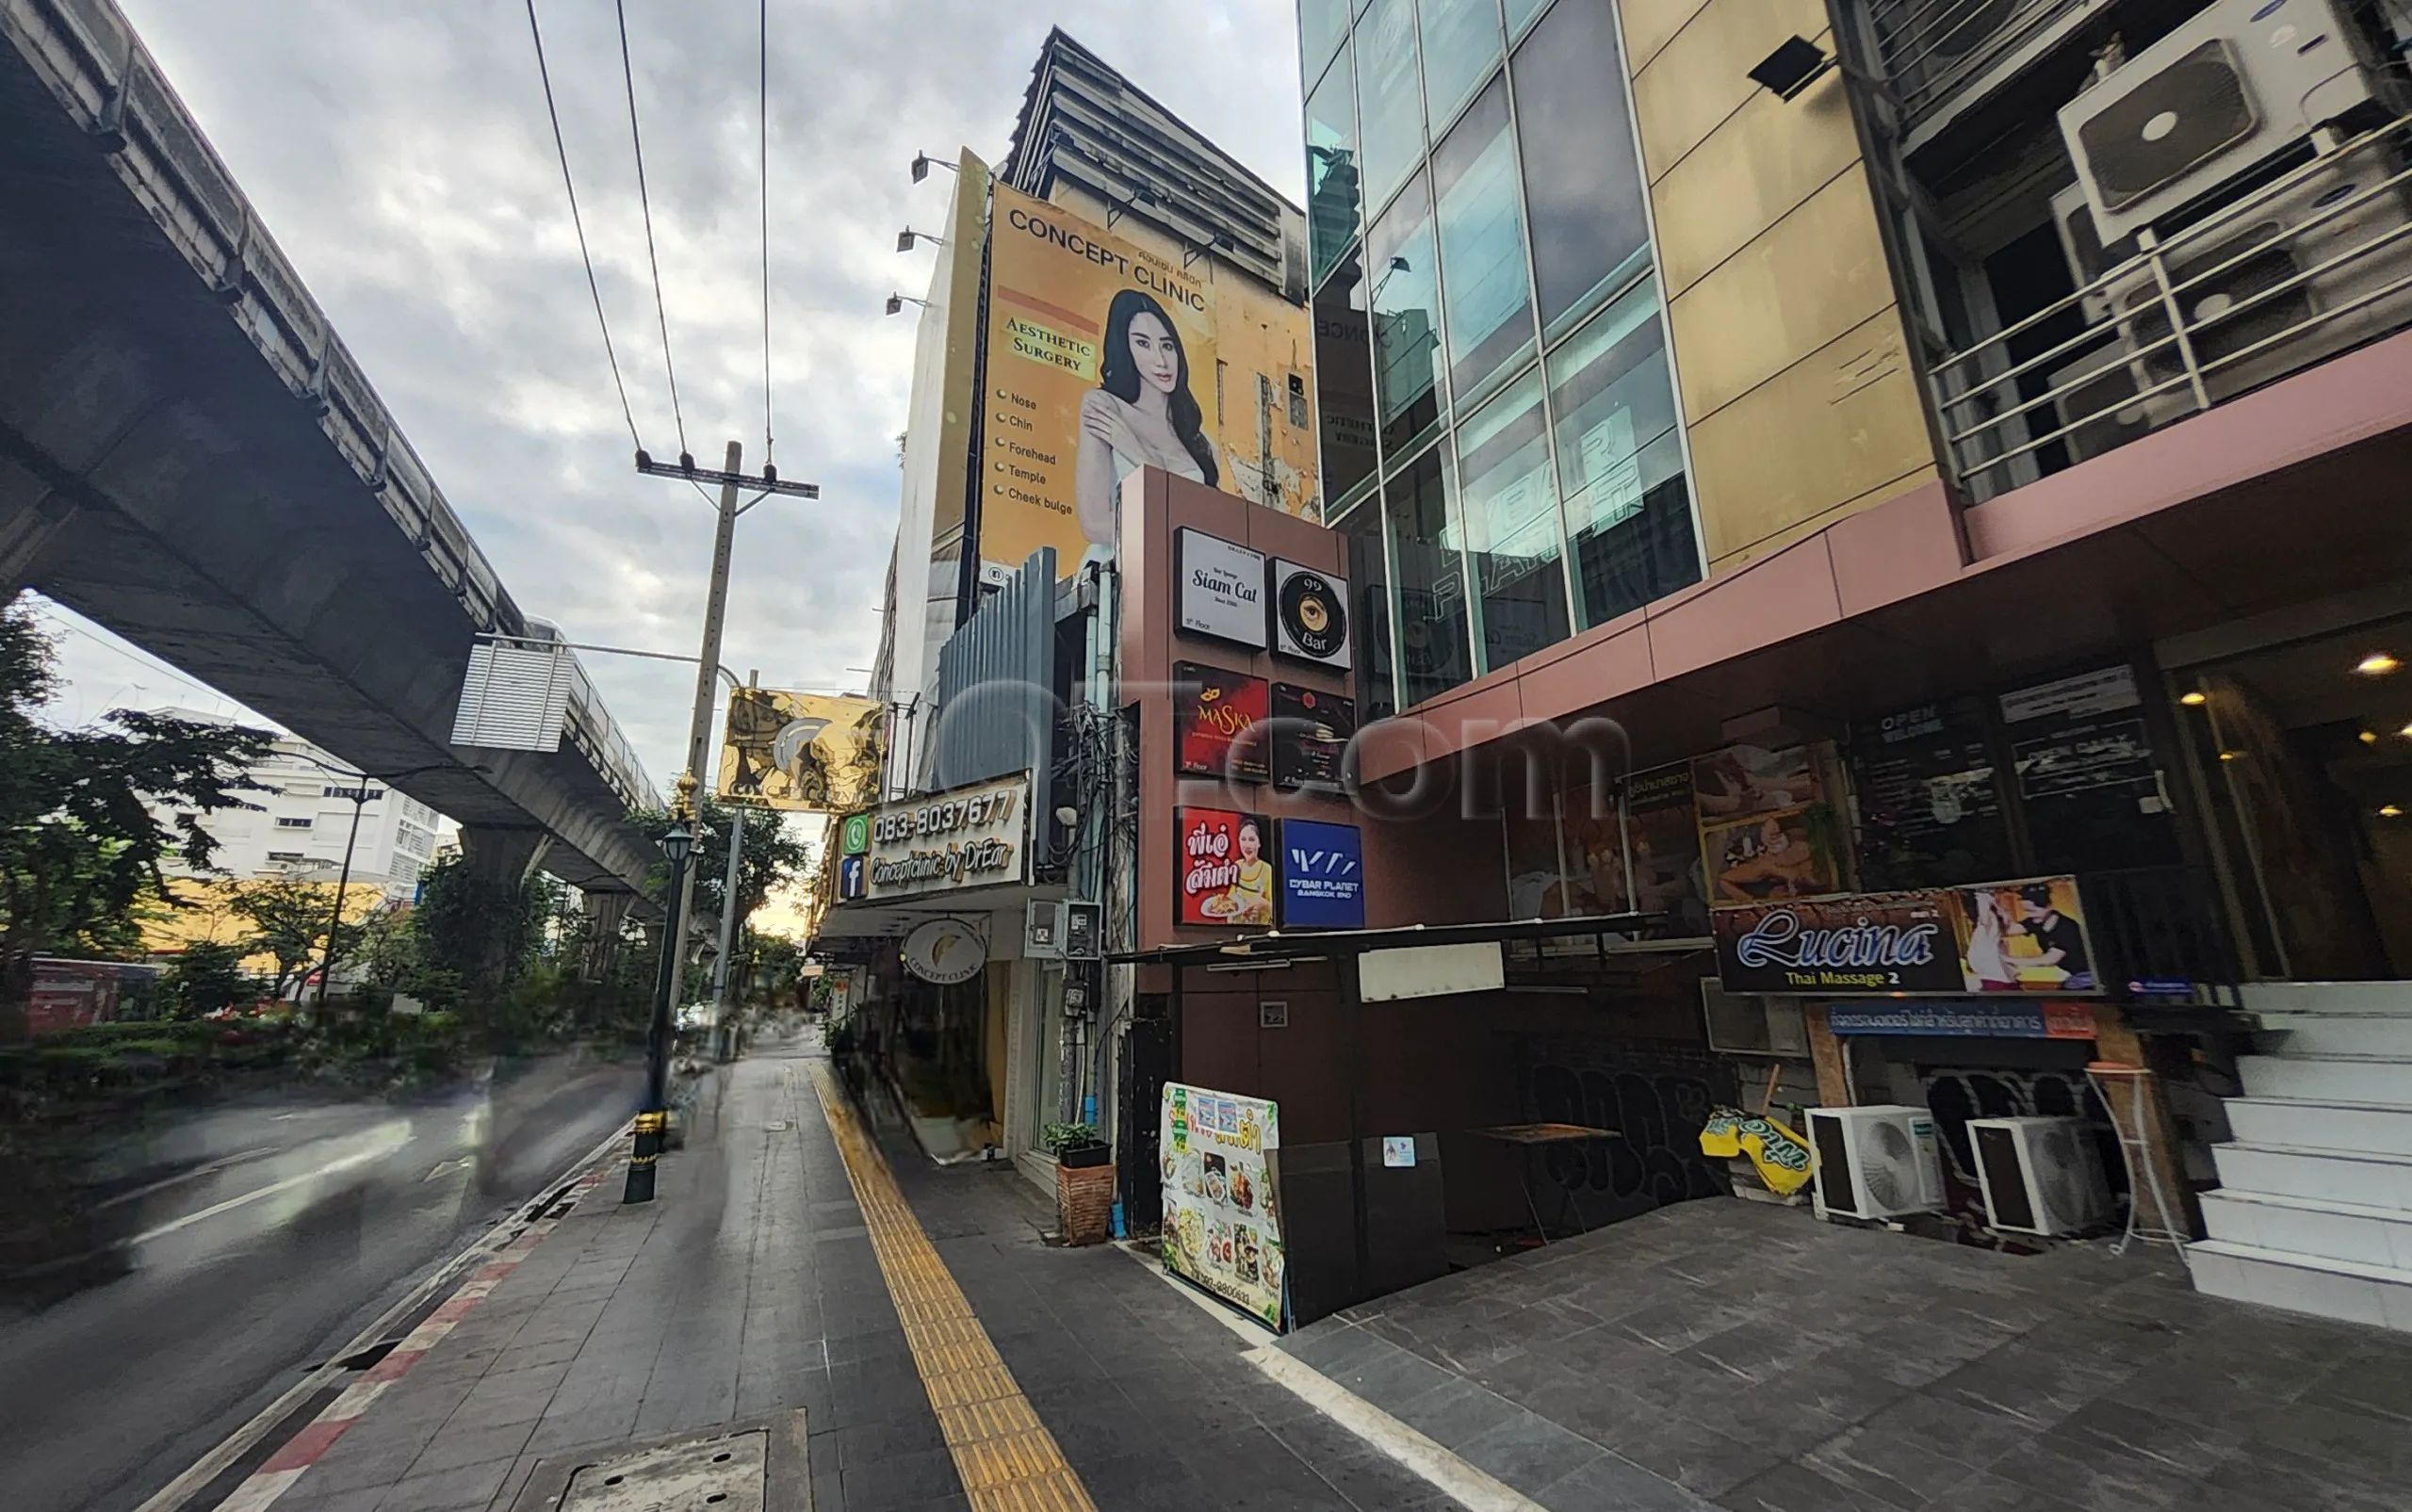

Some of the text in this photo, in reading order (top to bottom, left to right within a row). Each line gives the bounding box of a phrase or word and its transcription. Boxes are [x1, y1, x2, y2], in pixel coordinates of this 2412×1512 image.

[1009, 209, 1205, 312] CONCEPT CLINIC
[1011, 393, 1036, 410] Nose
[1009, 415, 1034, 431] Chin
[1009, 442, 1056, 465] Forehead
[1009, 464, 1046, 484] Temple
[1008, 488, 1072, 515] Cheek bulge
[1192, 569, 1231, 595] Siam
[1303, 578, 1323, 592] 99
[1302, 631, 1328, 651] Bar
[1198, 705, 1256, 735] MASKA
[873, 790, 1011, 842] 083-8037677
[945, 842, 961, 880] by
[1737, 908, 1939, 967] Lucina
[1785, 971, 1901, 987] Thai Massage 2
